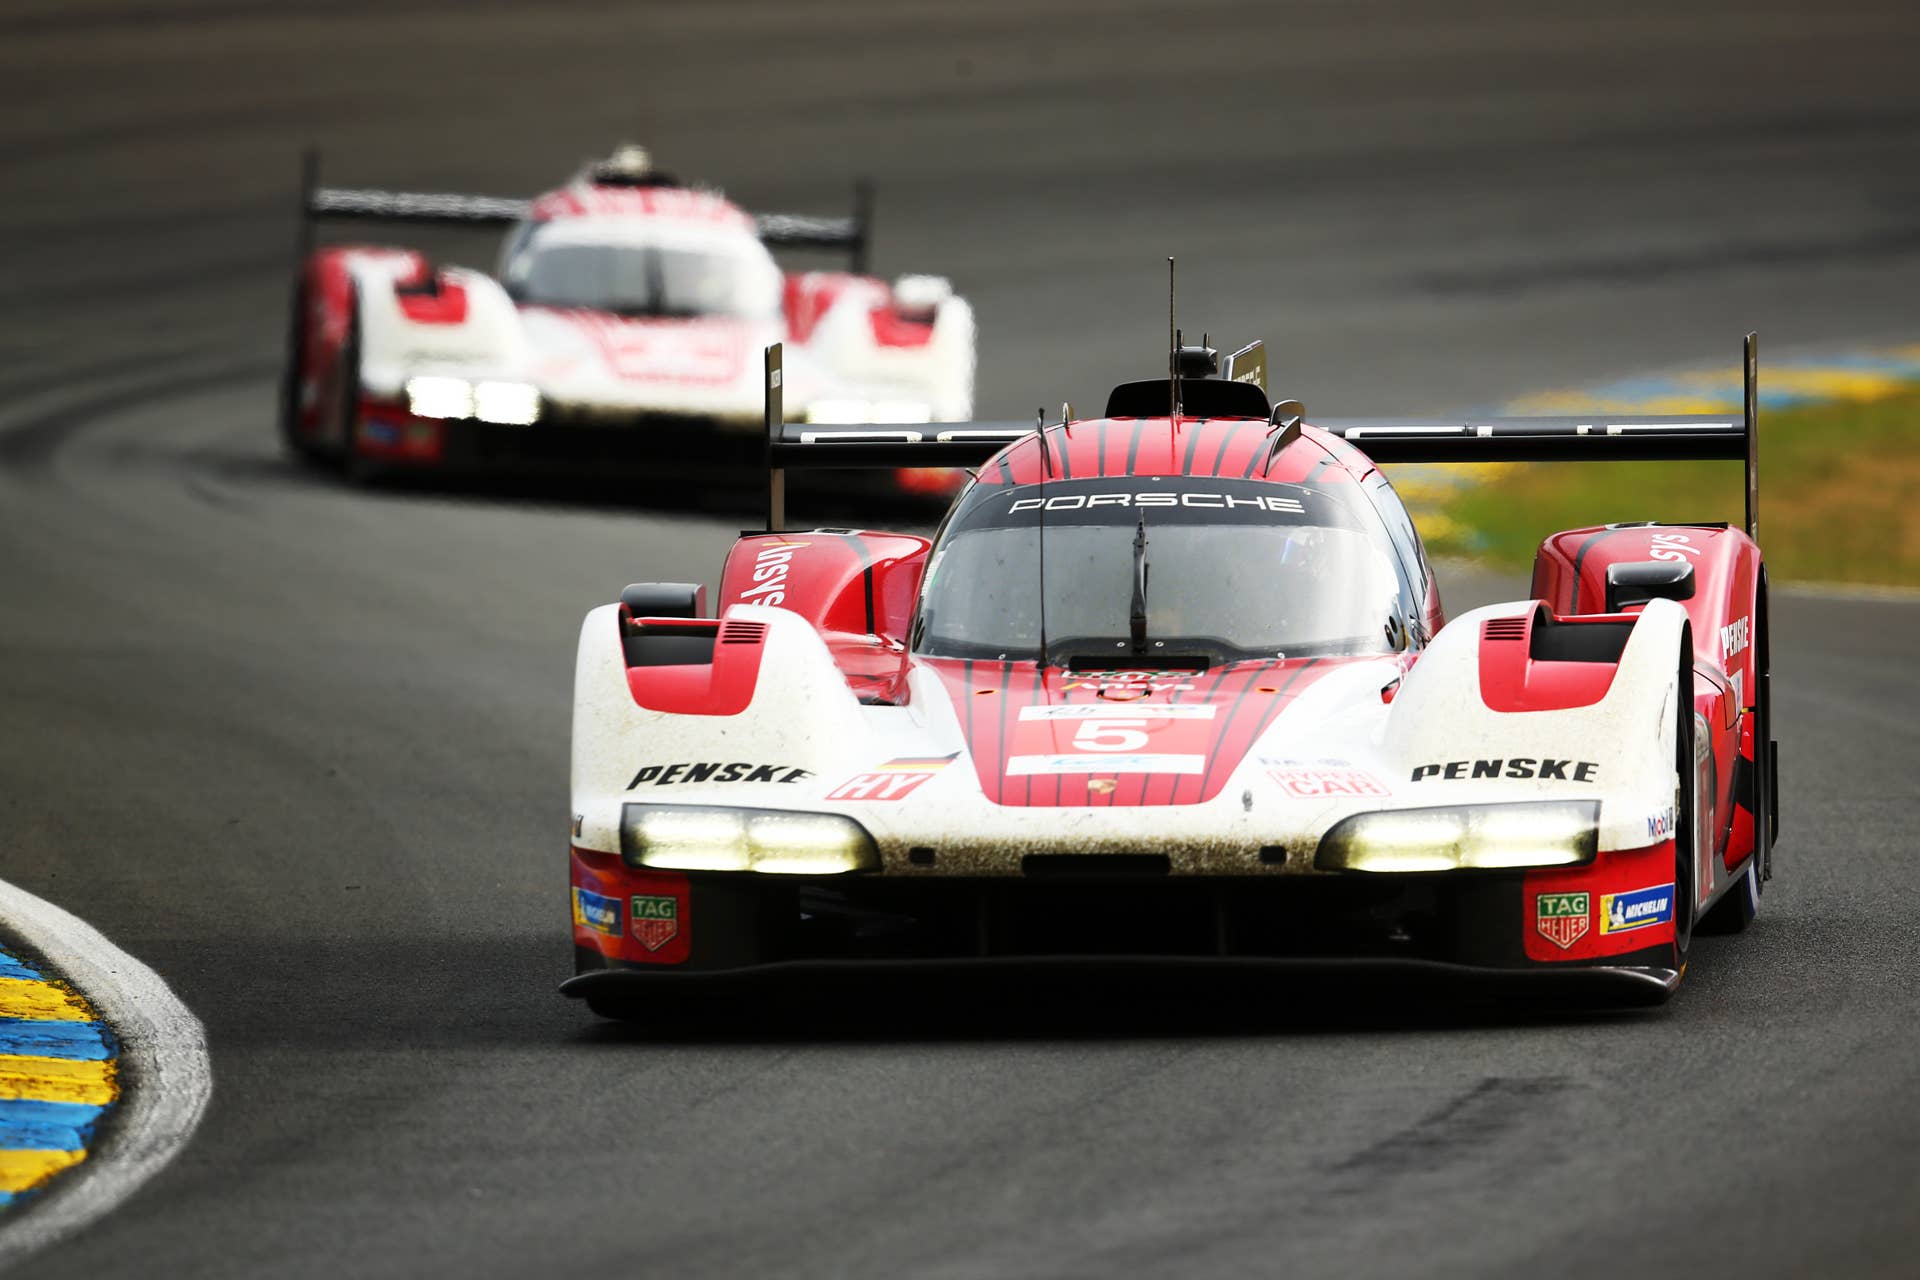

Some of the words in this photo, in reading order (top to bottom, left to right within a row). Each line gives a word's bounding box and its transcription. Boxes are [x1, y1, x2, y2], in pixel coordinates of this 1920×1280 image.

[1008, 493, 1304, 514] PORSCHE
[1072, 719, 1149, 752] 5
[626, 762, 816, 790] PENSKE
[1410, 758, 1600, 782] PENSKE
[835, 774, 920, 799] HY
[1289, 780, 1380, 795] CAR
[634, 900, 672, 916] TAG
[1543, 897, 1585, 913] TAG
[1625, 898, 1668, 919] MICHELIN
[1541, 917, 1586, 943] HEUER
